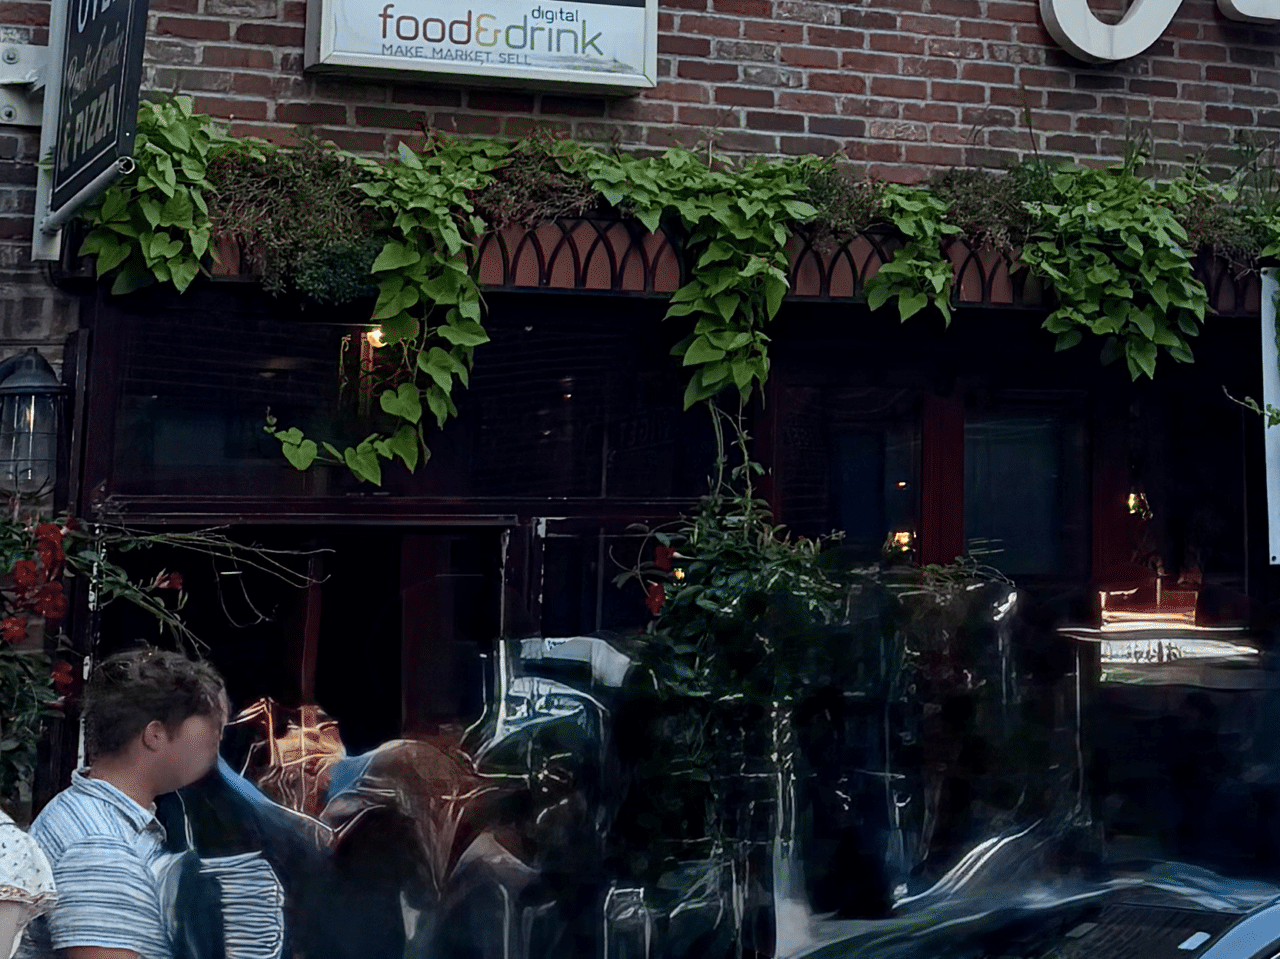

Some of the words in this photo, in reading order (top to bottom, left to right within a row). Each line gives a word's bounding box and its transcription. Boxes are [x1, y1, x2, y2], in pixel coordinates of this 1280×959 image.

[532, 6, 579, 24] digital
[498, 52, 532, 66] SELL
[60, 122, 71, 171] &
[73, 84, 115, 163] PIZZA
